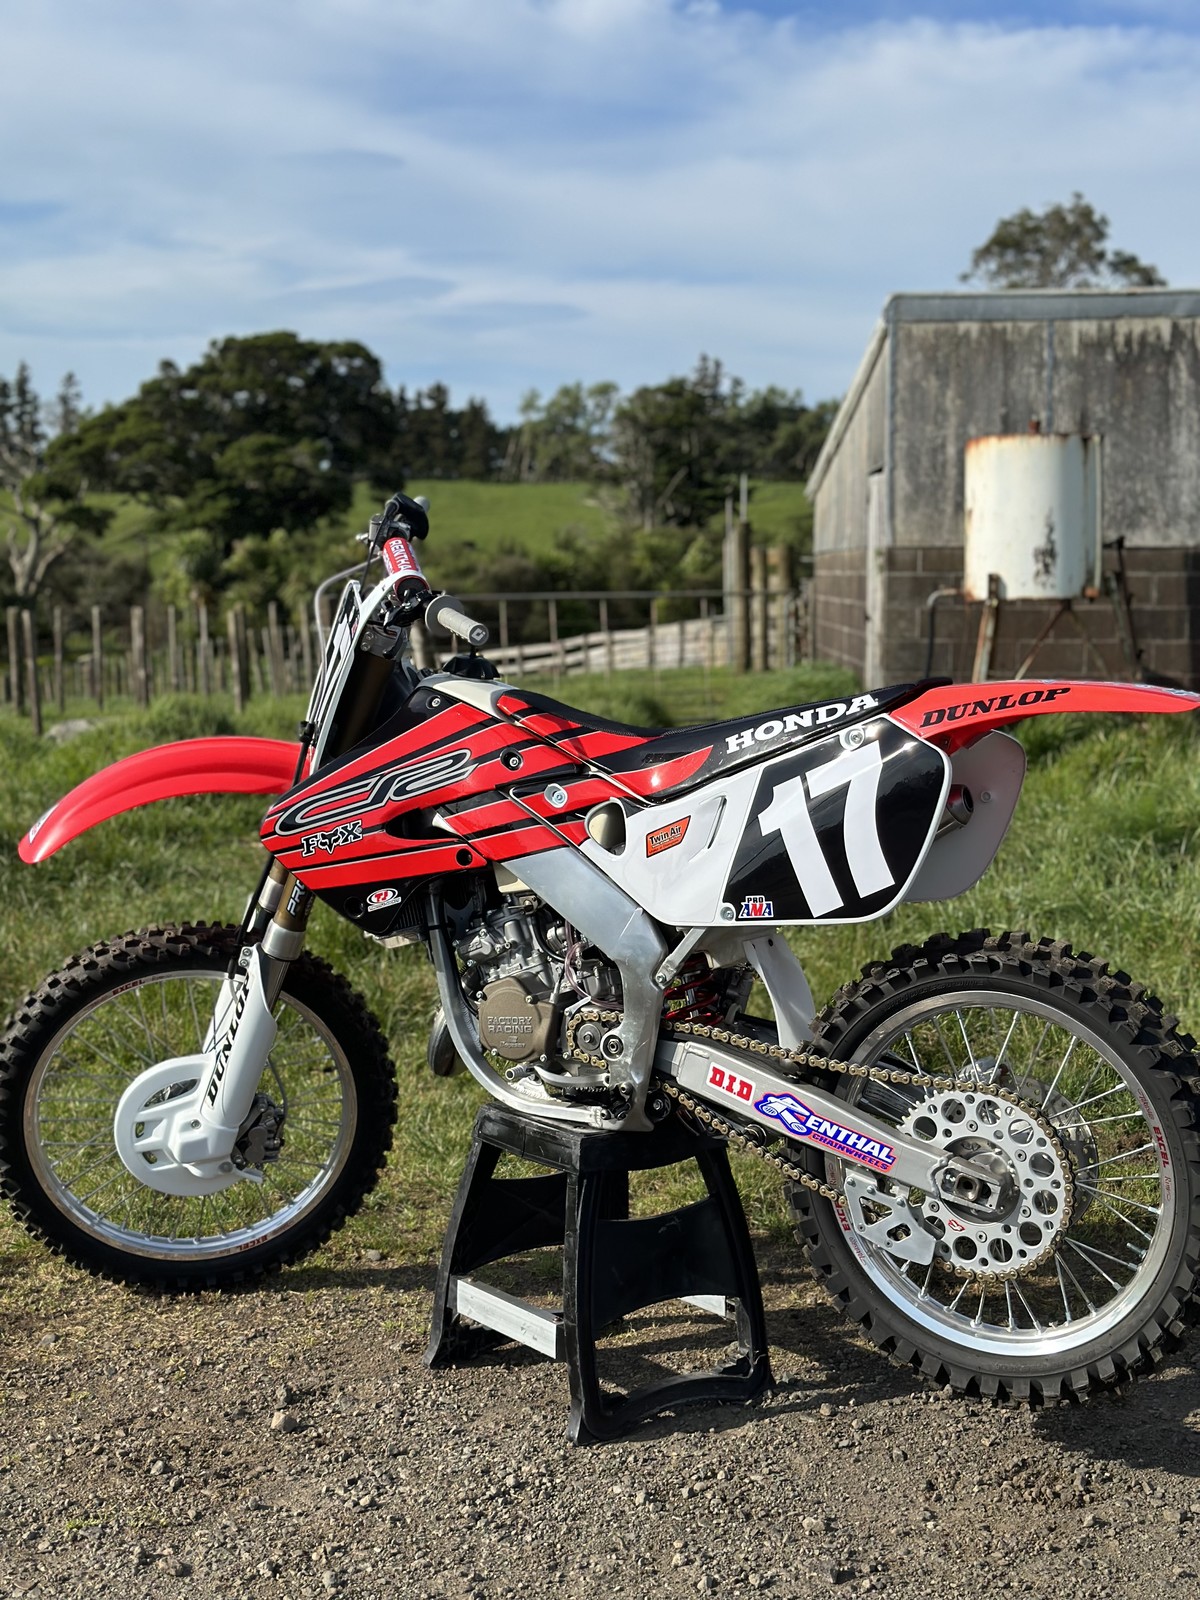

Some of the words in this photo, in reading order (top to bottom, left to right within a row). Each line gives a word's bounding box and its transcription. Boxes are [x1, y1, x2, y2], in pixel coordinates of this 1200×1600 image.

[389, 540, 412, 571] RENTHA
[725, 694, 878, 754] HONDA
[919, 687, 1070, 728] DUNLOP
[274, 749, 479, 836] CR
[301, 820, 363, 857] FOX
[649, 832, 669, 845] Twin
[670, 825, 682, 836] Air
[757, 740, 895, 918] 17
[740, 902, 773, 917] AMA
[746, 896, 764, 904] PRO
[207, 969, 250, 1107] DUNLOP
[487, 1016, 533, 1025] FACTORY
[487, 1025, 533, 1034] RACING
[709, 1066, 753, 1102] D.I.D
[811, 1132, 889, 1171] CHAINWHEELS
[1153, 1126, 1169, 1168] EXCEL
[834, 1201, 851, 1231] EXCE
